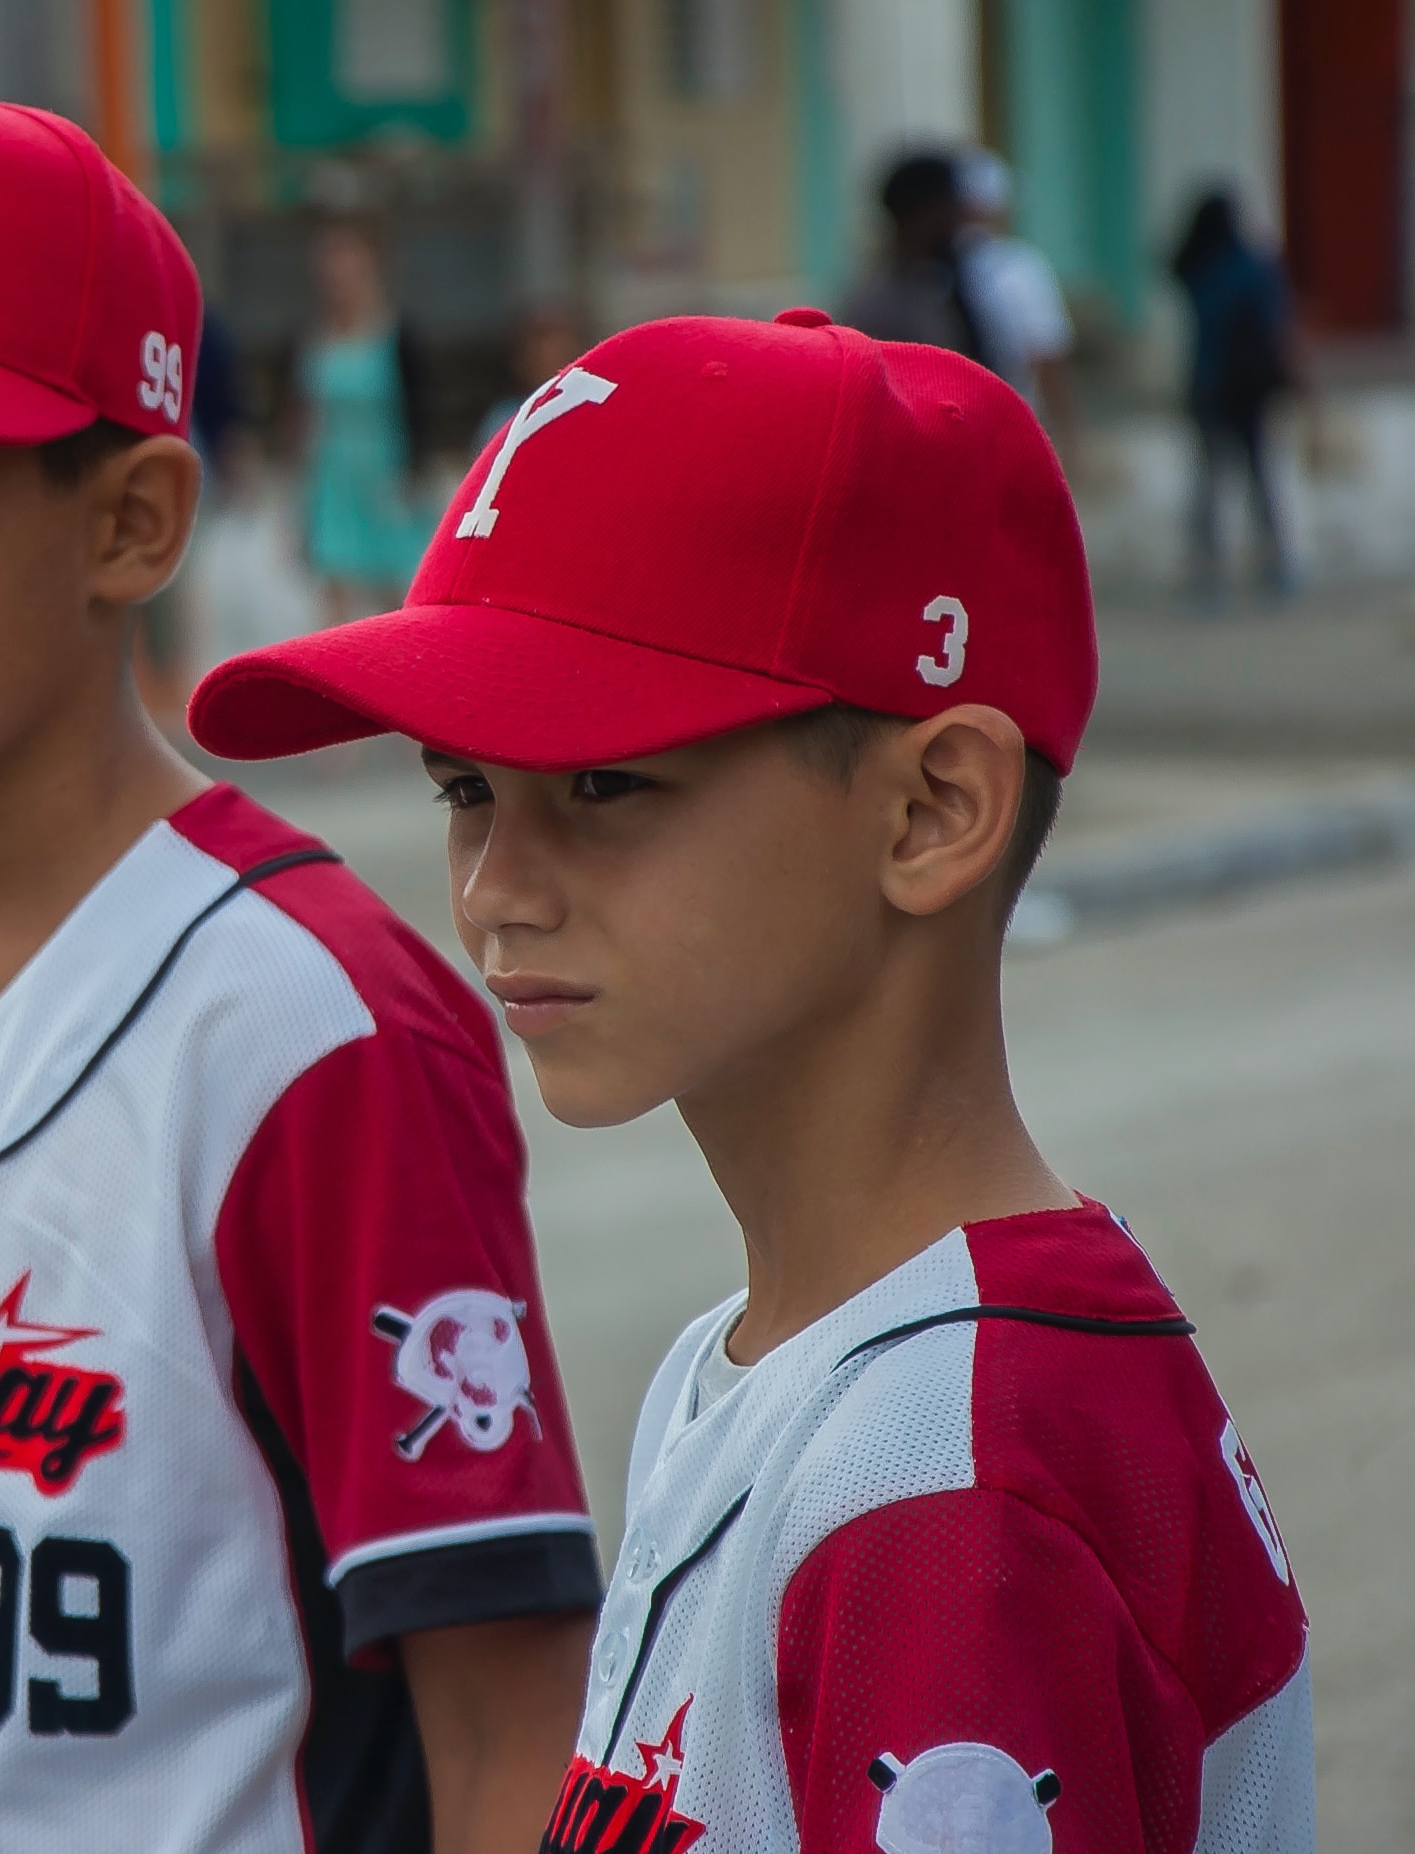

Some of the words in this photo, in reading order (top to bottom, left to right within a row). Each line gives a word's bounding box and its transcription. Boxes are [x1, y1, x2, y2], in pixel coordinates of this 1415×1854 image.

[137, 331, 183, 424] 99
[456, 367, 618, 539] Y
[916, 595, 969, 687] 3
